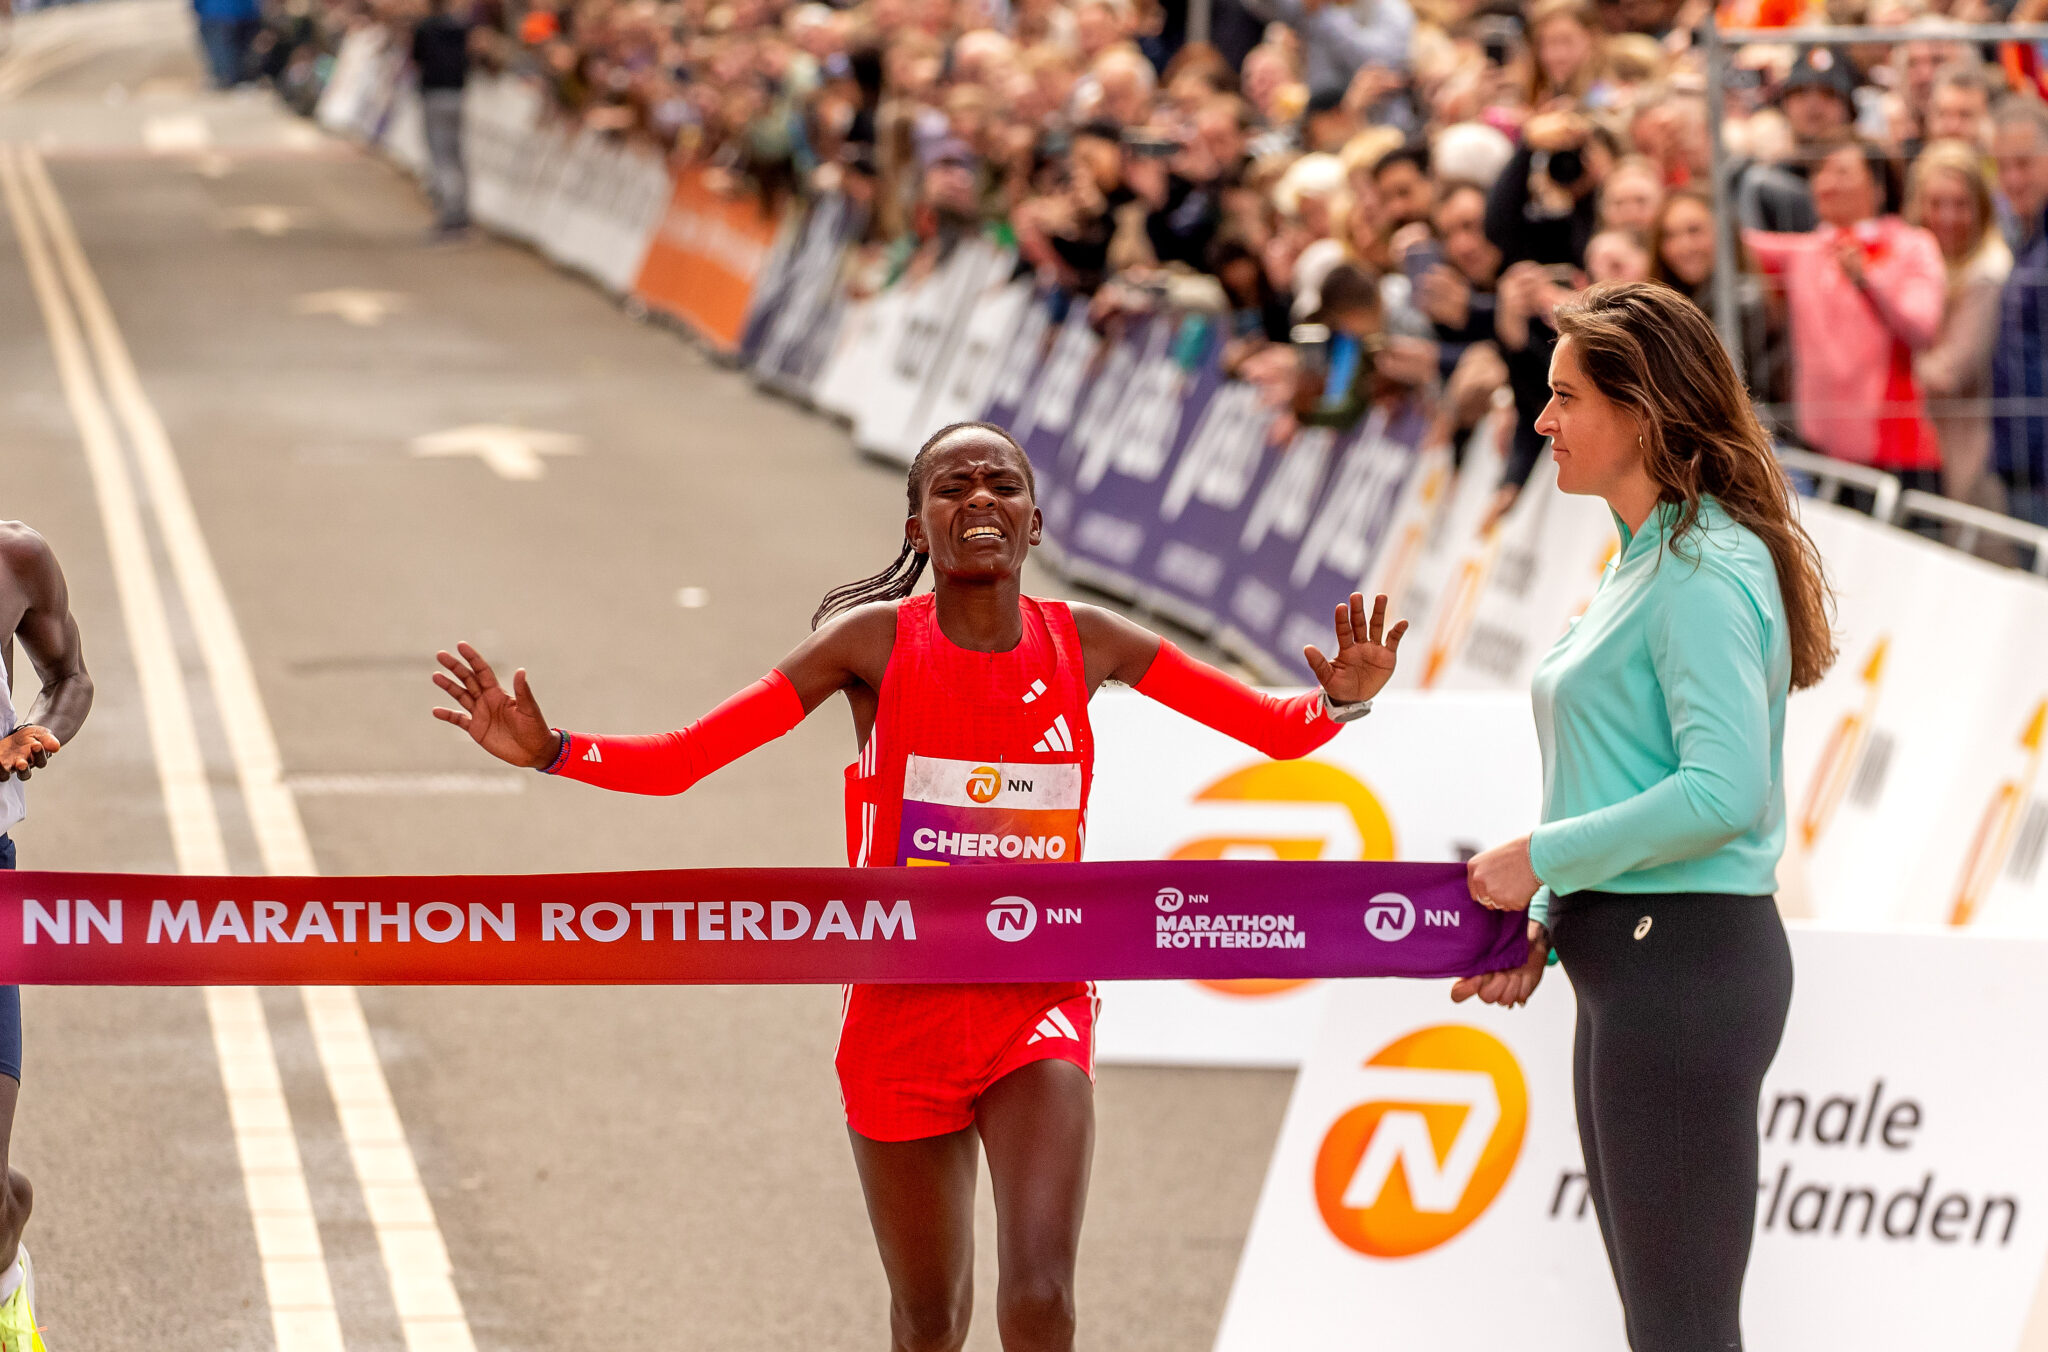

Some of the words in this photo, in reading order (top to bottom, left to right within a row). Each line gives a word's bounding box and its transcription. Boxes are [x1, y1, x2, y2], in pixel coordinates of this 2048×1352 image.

[1007, 779, 1034, 793] NN
[912, 827, 1067, 860] CHERONO
[1188, 894, 1209, 904] NN
[22, 899, 123, 945] NN
[146, 900, 517, 944] MARATHON
[540, 900, 918, 943] ROTTERDAM
[1045, 907, 1082, 924] NN
[1155, 914, 1296, 932] MARATHON
[1423, 908, 1461, 927] NN
[1155, 931, 1307, 949] ROTTERDAM
